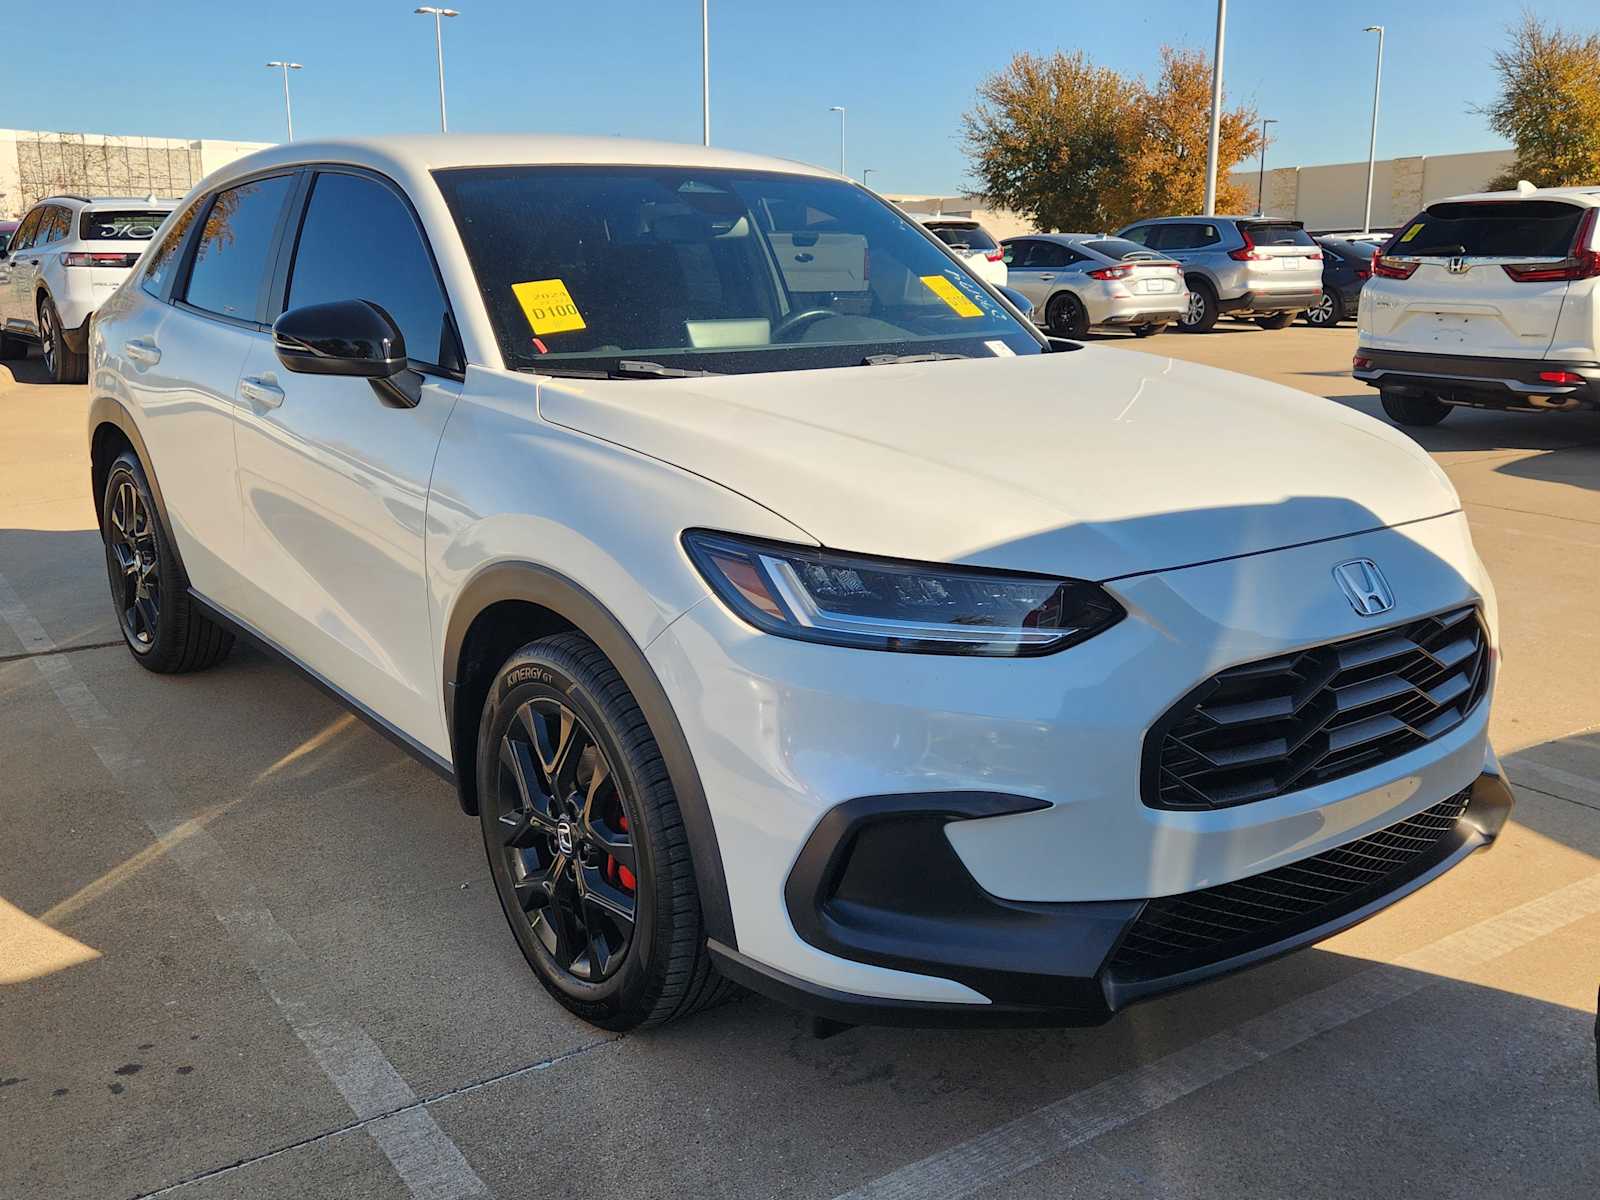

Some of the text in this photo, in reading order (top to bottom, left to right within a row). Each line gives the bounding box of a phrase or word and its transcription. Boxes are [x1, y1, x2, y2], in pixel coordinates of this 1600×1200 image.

[533, 303, 577, 320] D100
[507, 667, 553, 688] KINERGY GT
